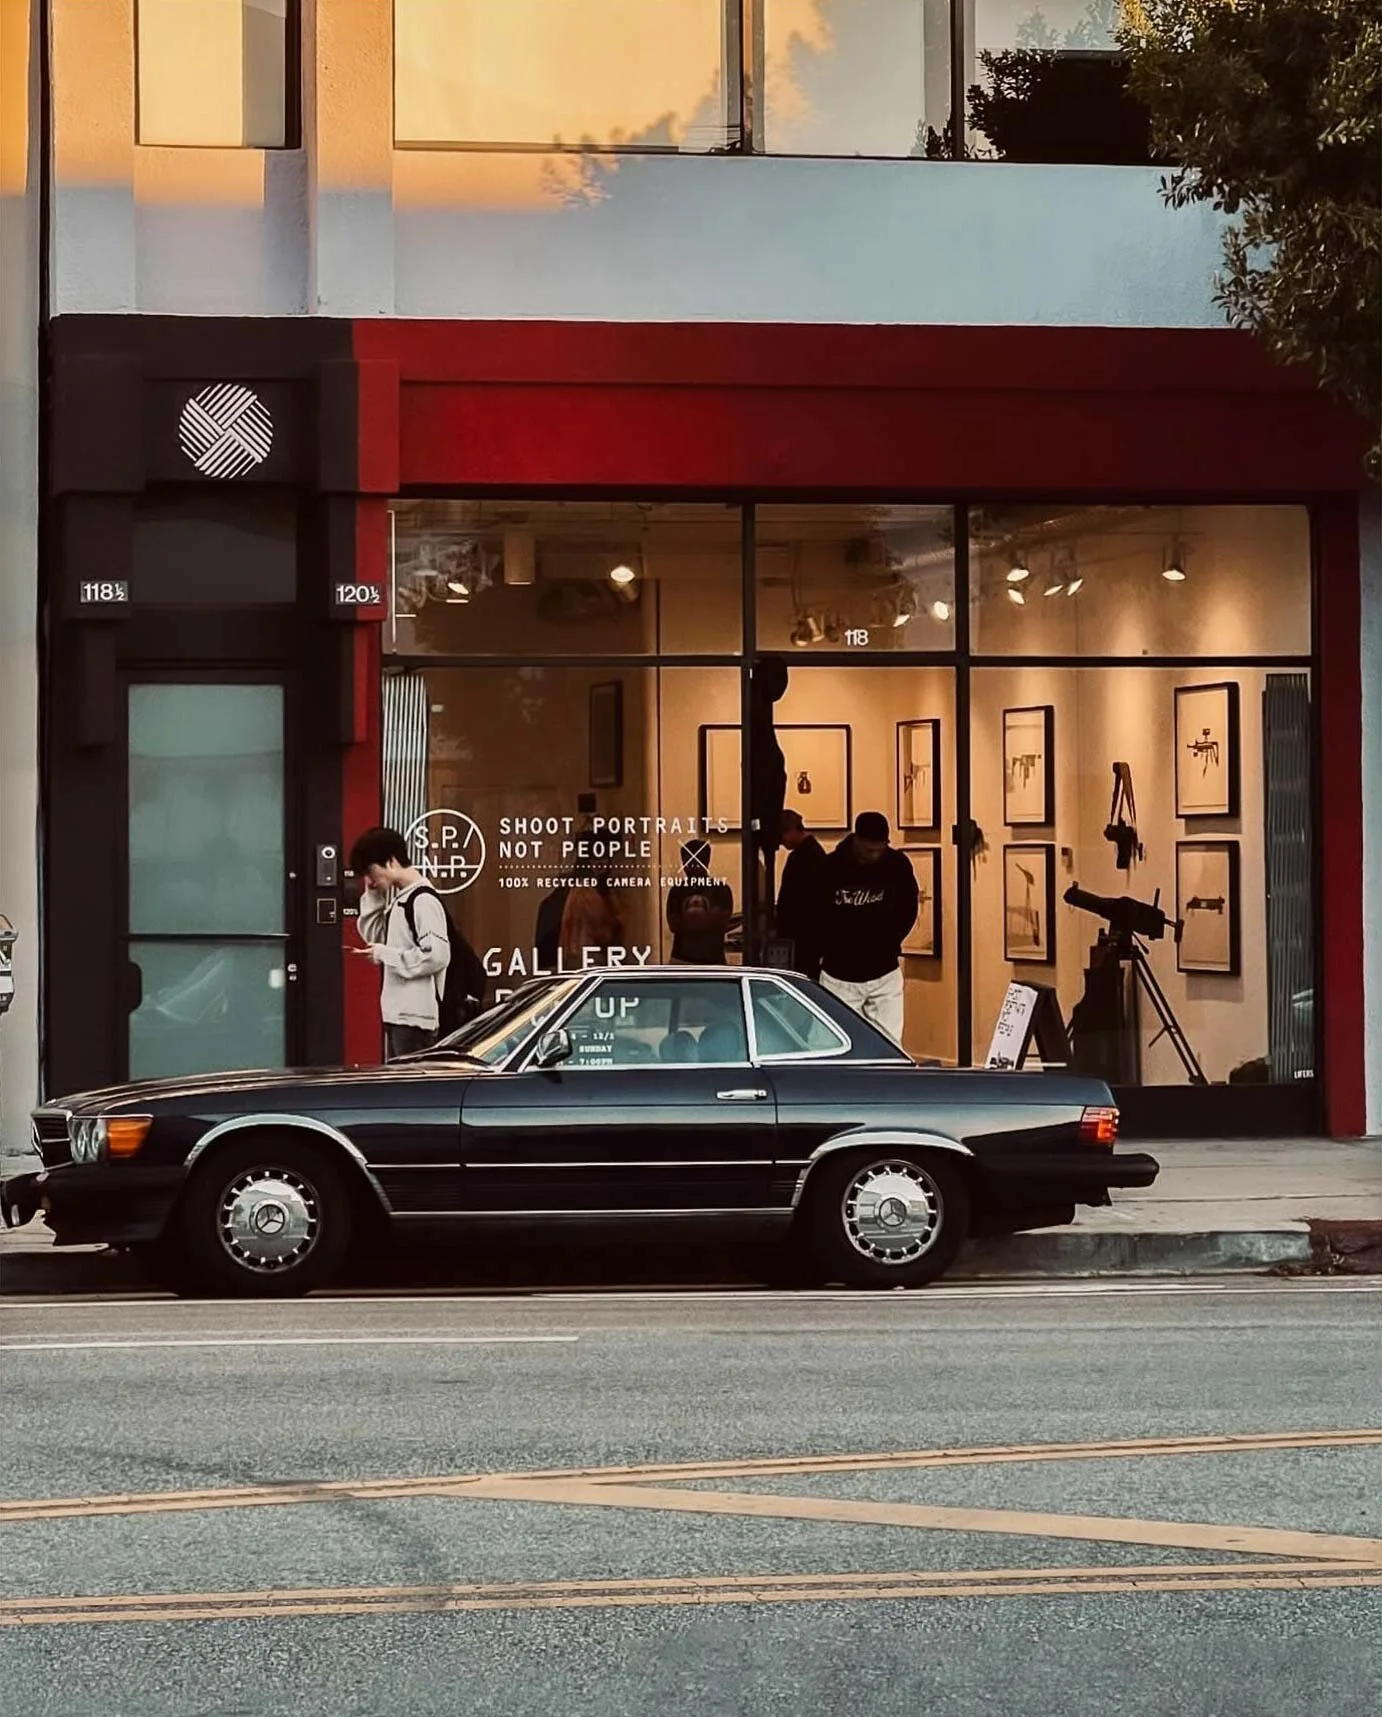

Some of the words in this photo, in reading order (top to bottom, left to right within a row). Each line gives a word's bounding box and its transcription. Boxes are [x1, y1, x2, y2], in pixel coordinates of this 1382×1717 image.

[844, 629, 869, 646] 118
[499, 817, 575, 834] SHOOT
[593, 817, 729, 834] PORTRAITS
[499, 841, 544, 859] NOT
[562, 841, 652, 858] PEOPLE
[498, 877, 529, 888] 100%
[536, 877, 599, 888] RECYCLED
[606, 877, 652, 887] CAMERA
[660, 876, 729, 887] EQUIPMENT
[482, 946, 652, 977] GALLERY
[594, 997, 640, 1018] UP
